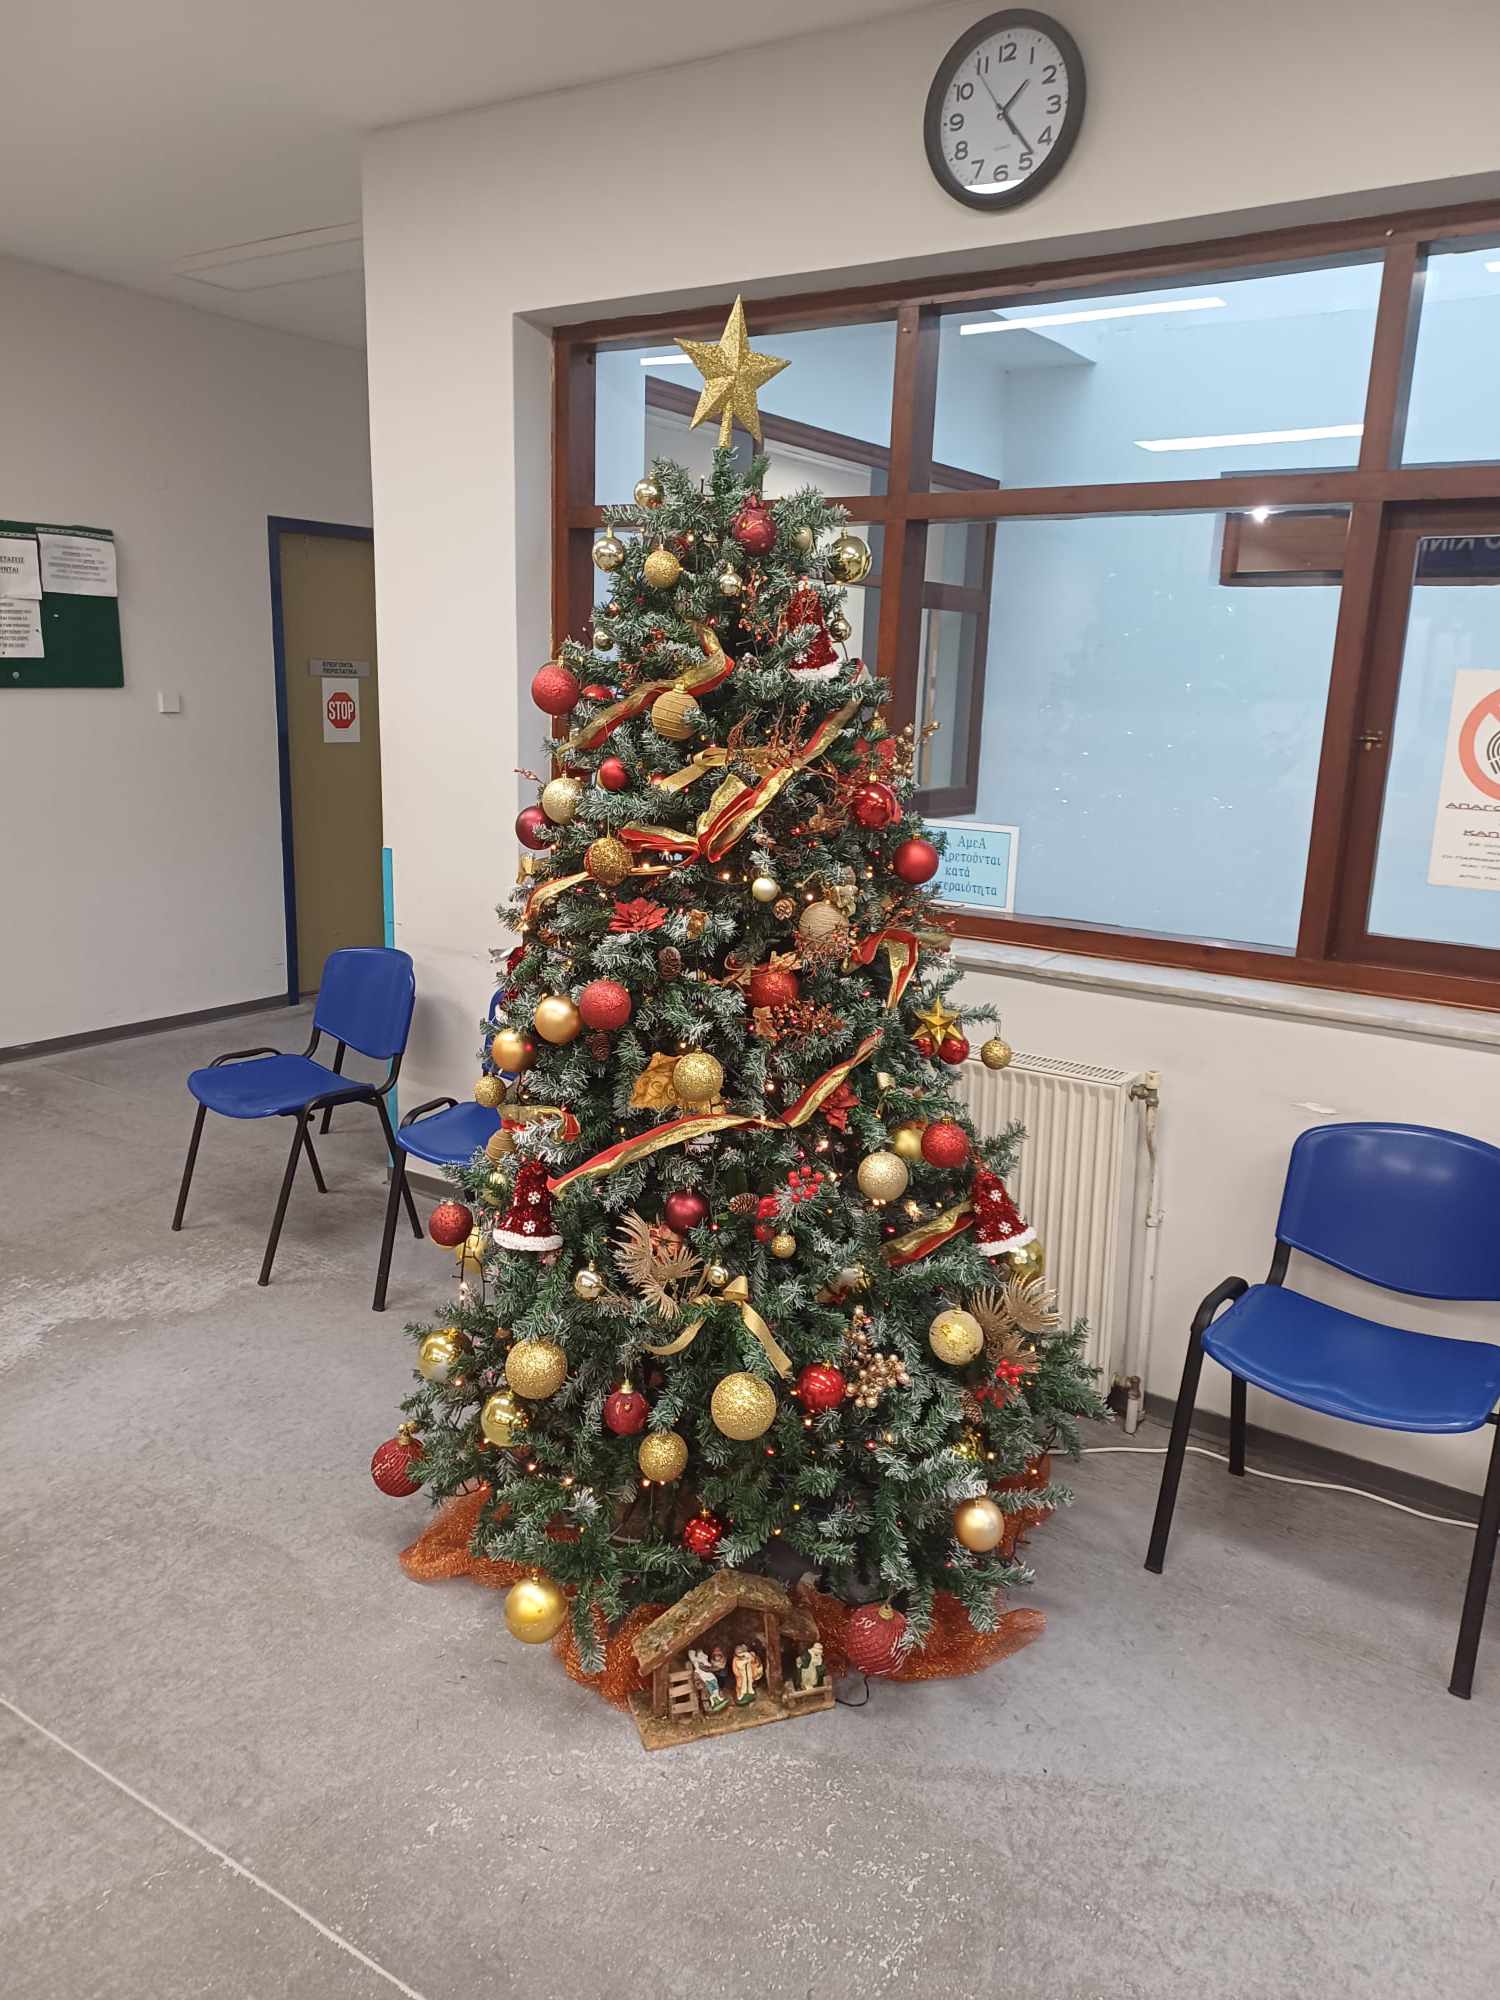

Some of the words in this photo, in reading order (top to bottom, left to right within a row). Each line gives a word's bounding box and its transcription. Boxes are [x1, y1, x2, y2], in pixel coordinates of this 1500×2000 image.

[998, 42, 1017, 63] 12
[1029, 46, 1035, 64] 1
[976, 56, 989, 75] 11
[1041, 65, 1057, 85] 2
[955, 82, 974, 102] 10
[1046, 94, 1061, 114] 3
[949, 113, 964, 132] 9
[1037, 125, 1052, 145] 4
[954, 140, 968, 160] 8
[971, 159, 985, 179] 7
[1018, 151, 1034, 171] 5
[993, 164, 1009, 182] 6
[328, 701, 354, 720] STOP
[957, 835, 987, 850] ΑμεΑ
[945, 866, 970, 878] κατά
